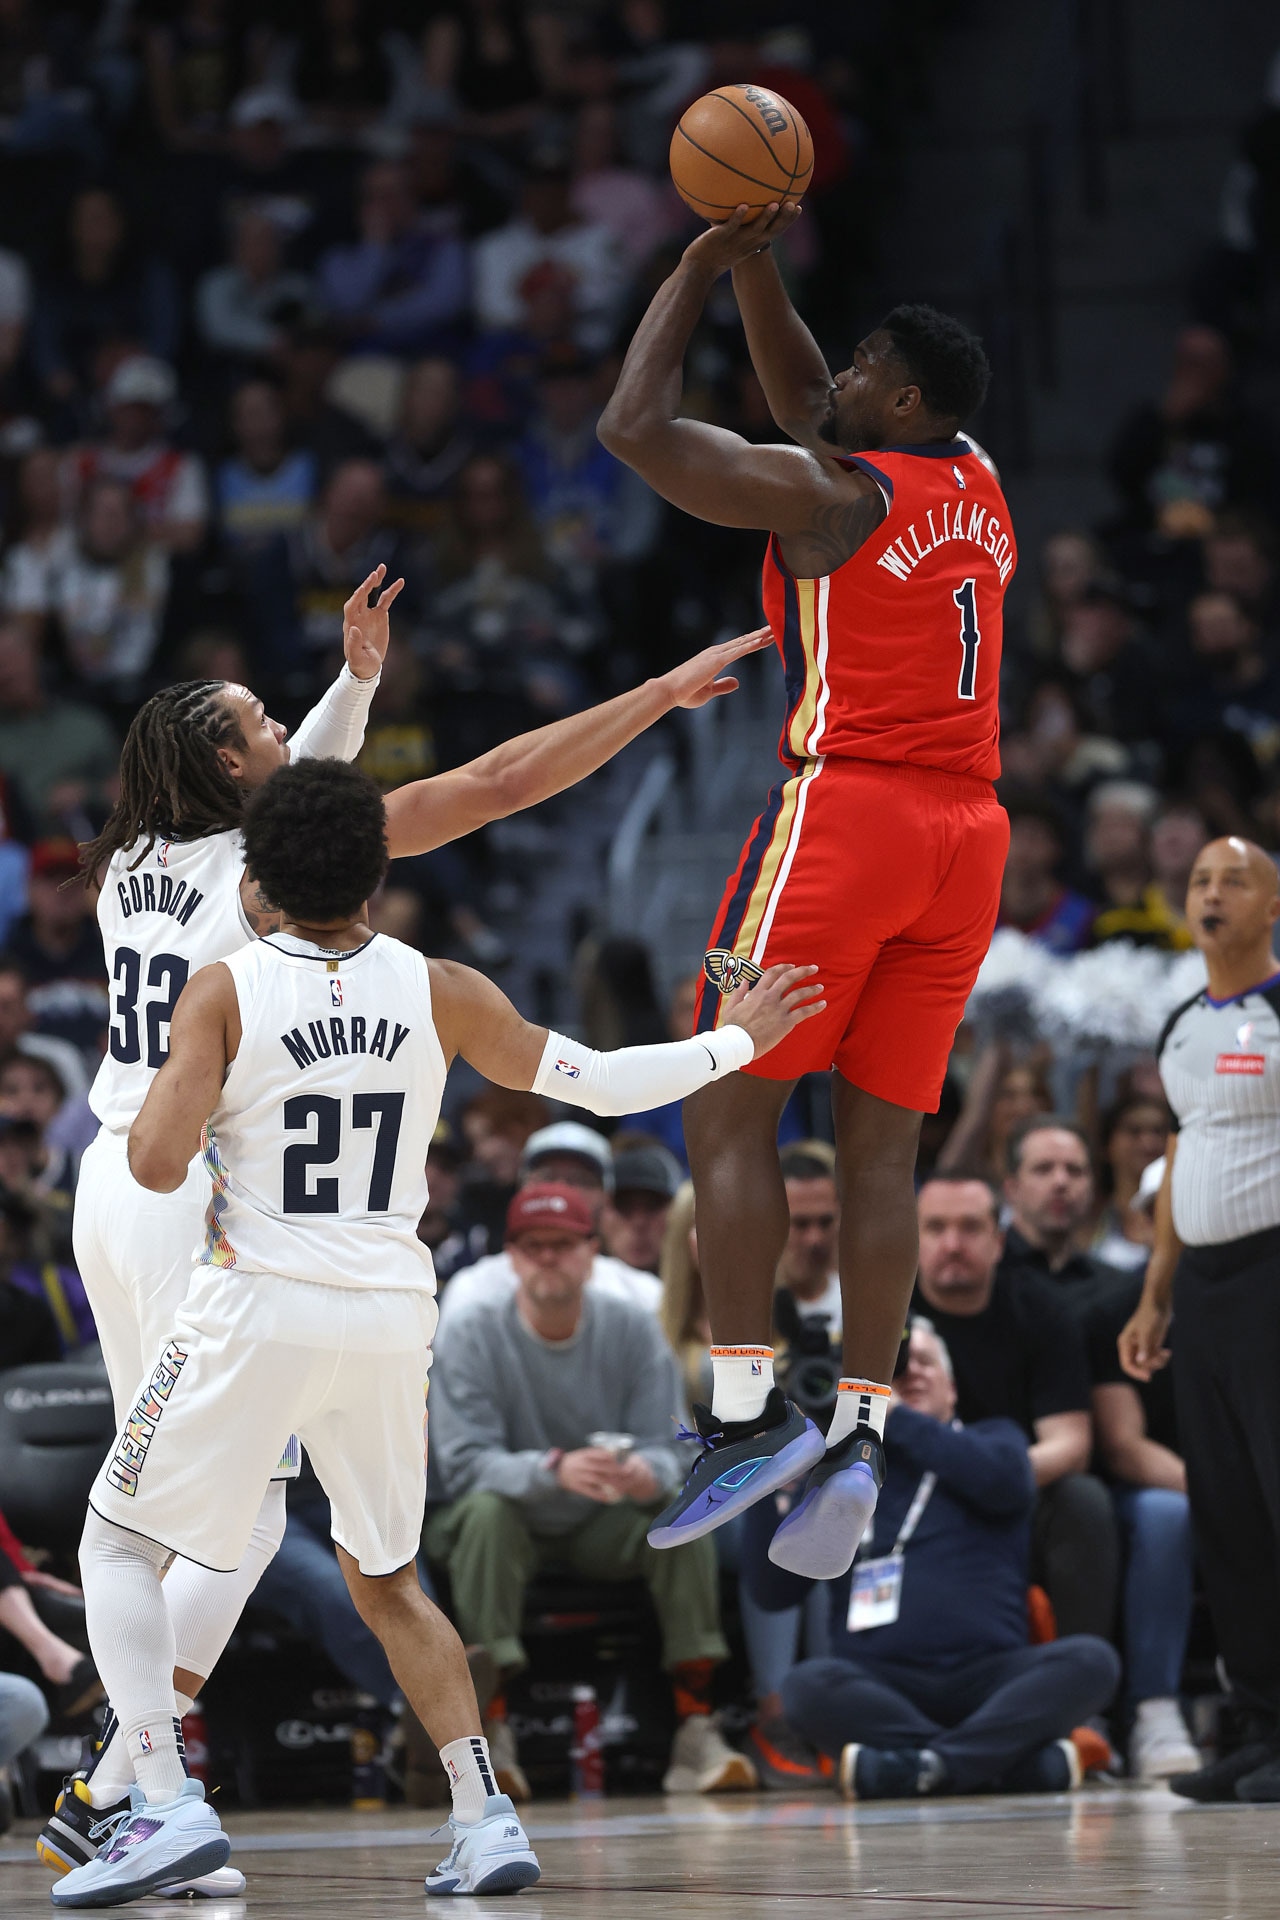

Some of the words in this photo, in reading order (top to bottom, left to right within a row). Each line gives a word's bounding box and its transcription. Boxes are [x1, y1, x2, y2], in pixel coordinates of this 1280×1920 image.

[876, 501, 1013, 586] WILLIAMSON
[953, 578, 981, 700] 1
[117, 873, 204, 927] GORDON
[110, 947, 189, 1070] 32
[280, 1016, 411, 1070] MURRAY
[283, 1092, 406, 1214] 27
[106, 1341, 188, 1497] DENVER
